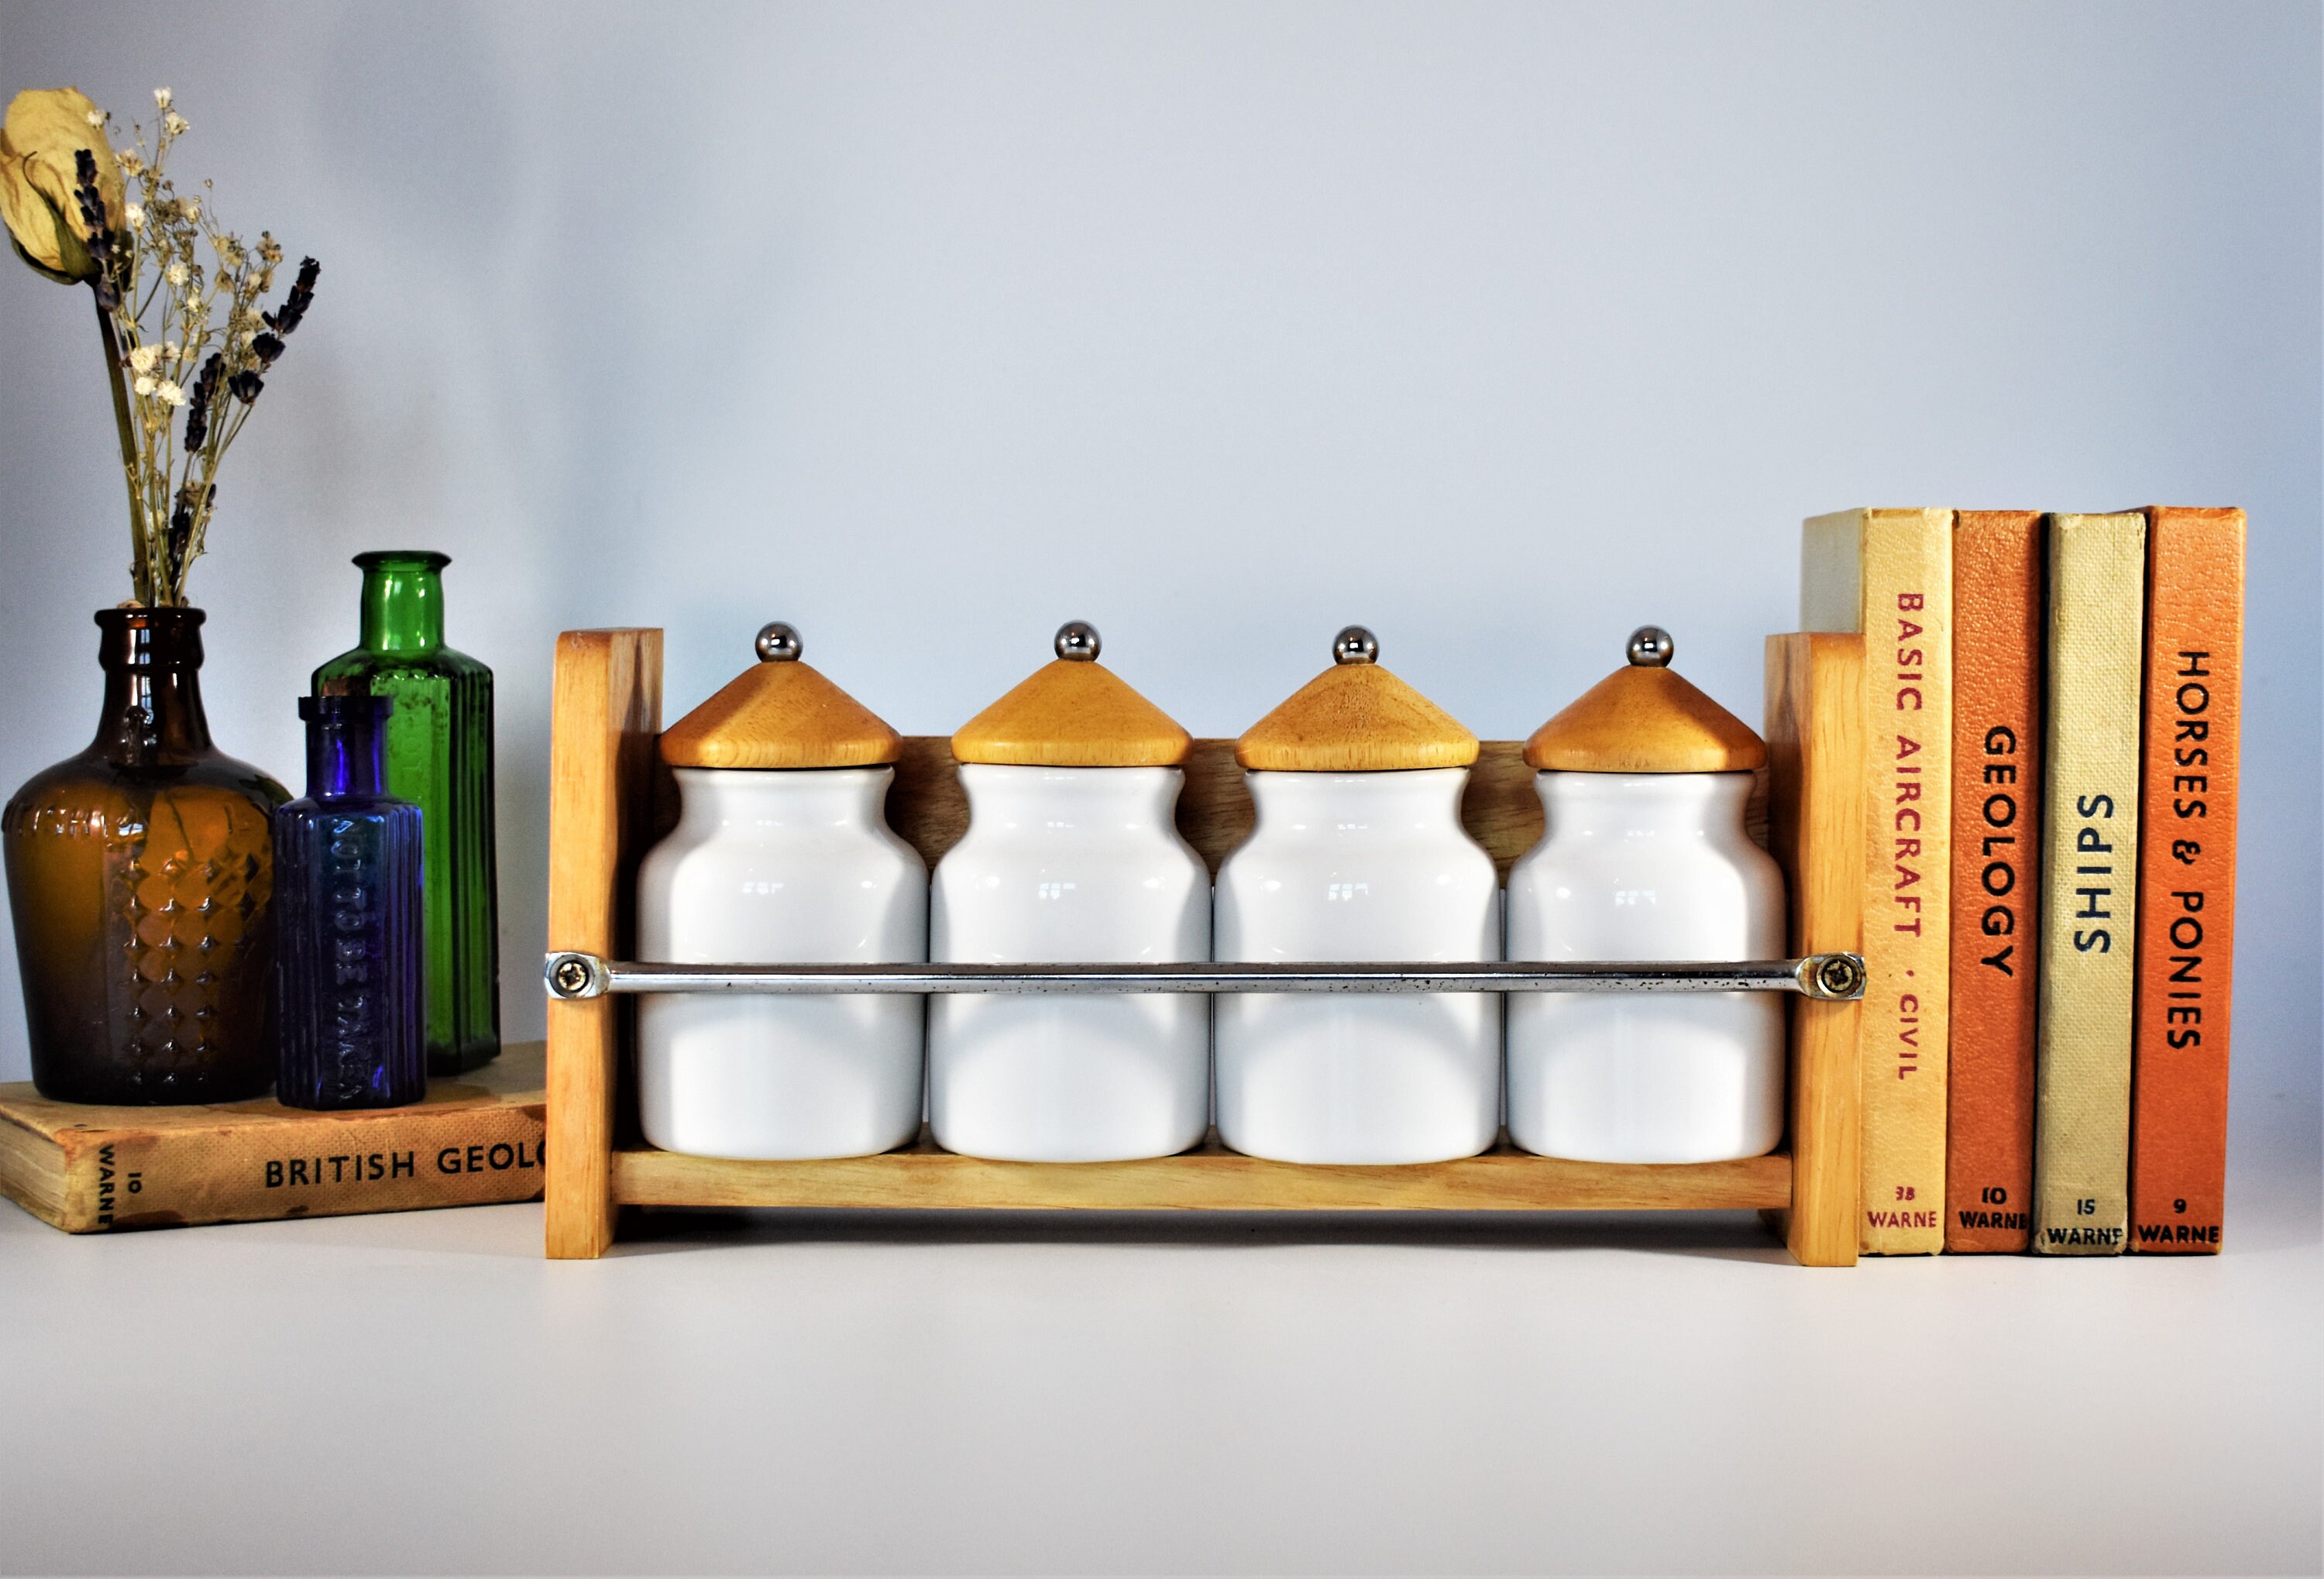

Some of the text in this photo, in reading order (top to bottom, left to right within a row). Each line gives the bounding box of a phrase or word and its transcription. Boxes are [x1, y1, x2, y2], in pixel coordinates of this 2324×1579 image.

[1893, 592, 1924, 1081] BASIC AIRCRAFT CIVIL
[1980, 724, 2018, 979] GEOLOGY
[2166, 650, 2211, 1050] HORSES & PONIES
[2073, 793, 2115, 955] SHIPS
[264, 1150, 416, 1189] BRITISH
[98, 1144, 115, 1224] WARNE
[127, 1171, 143, 1194] 10
[1981, 1186, 2008, 1206] 10
[2076, 1199, 2096, 1216] 15
[2172, 1198, 2188, 1215] 9
[1866, 1210, 1937, 1228] WARNE
[1958, 1210, 2027, 1230] WARNE
[2137, 1224, 2220, 1245] WARNE
